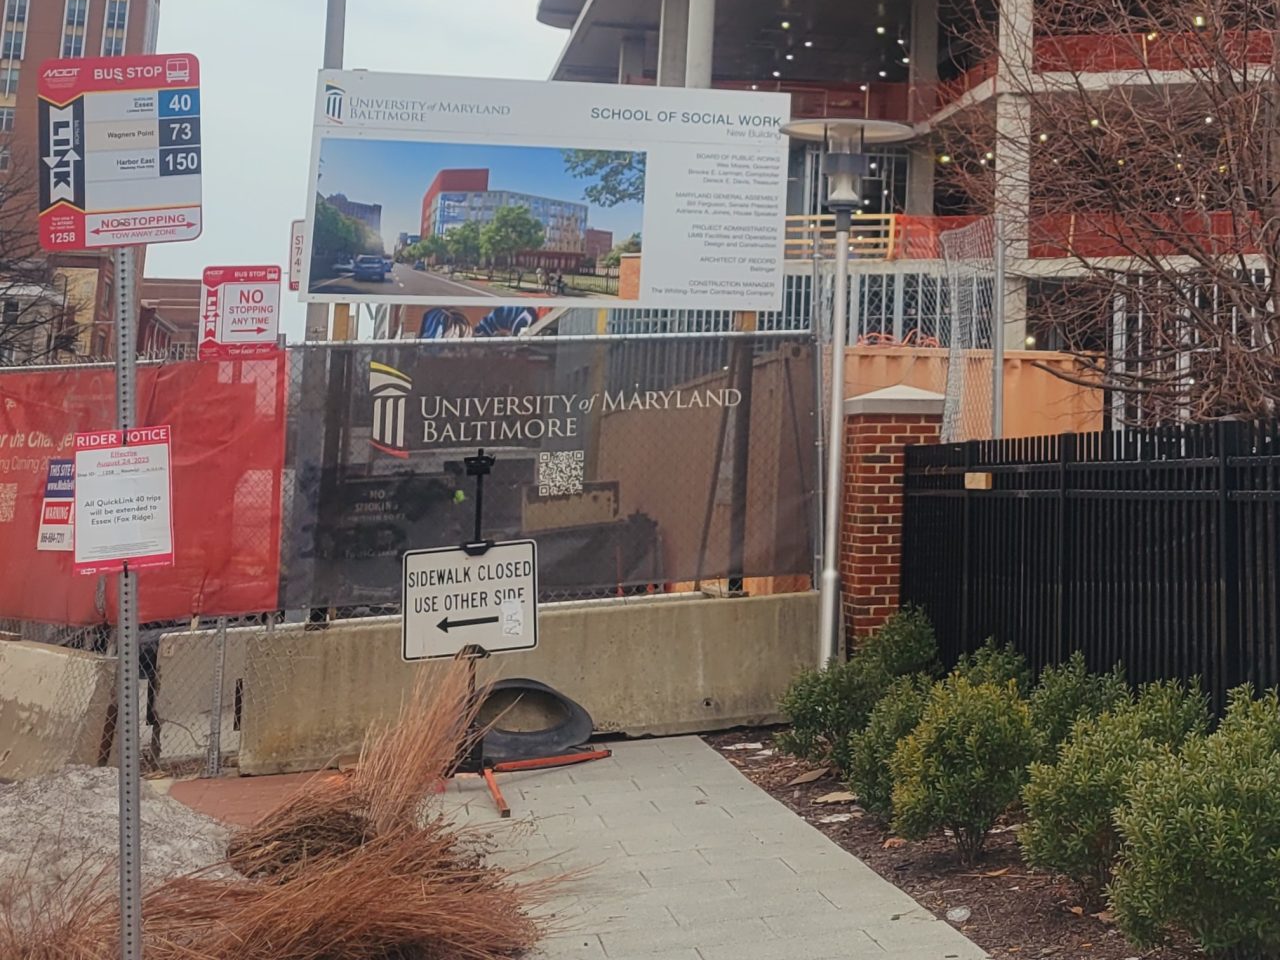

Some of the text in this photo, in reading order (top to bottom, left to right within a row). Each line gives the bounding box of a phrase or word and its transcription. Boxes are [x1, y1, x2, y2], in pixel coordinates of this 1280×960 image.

[94, 66, 162, 80] BUS STOP
[134, 94, 191, 112] Essex 40
[350, 97, 511, 115] UNIVERSITY of MARYLAND
[350, 109, 427, 122] BALTIMORE
[591, 107, 781, 127] SCHOOL OF SOCIAL WORK
[108, 131, 135, 139] Wagners
[170, 123, 191, 140] 73
[727, 129, 781, 140] New Building
[117, 158, 138, 166] Harbor
[165, 152, 198, 171] 150
[101, 214, 185, 229] NO STOPPING
[723, 225, 778, 233] ADMINISTRATION
[50, 232, 75, 244] 1258
[700, 256, 736, 264] ARCHITECT
[240, 289, 263, 304] NO
[229, 305, 273, 314] STOPPING
[231, 317, 269, 326] ANY TIME
[420, 388, 742, 419] UNIVERSITY of MARYLAND
[423, 417, 577, 443] BALTIMORE
[77, 433, 117, 447] RIDER
[97, 498, 134, 507] QuickLink
[45, 506, 69, 520] WARNING
[105, 507, 113, 515] be
[116, 506, 148, 514] extended
[114, 516, 129, 524] (Fox
[408, 561, 531, 588] SIDEWALK CLOSED
[415, 587, 525, 613] USE OTHER SIDE
